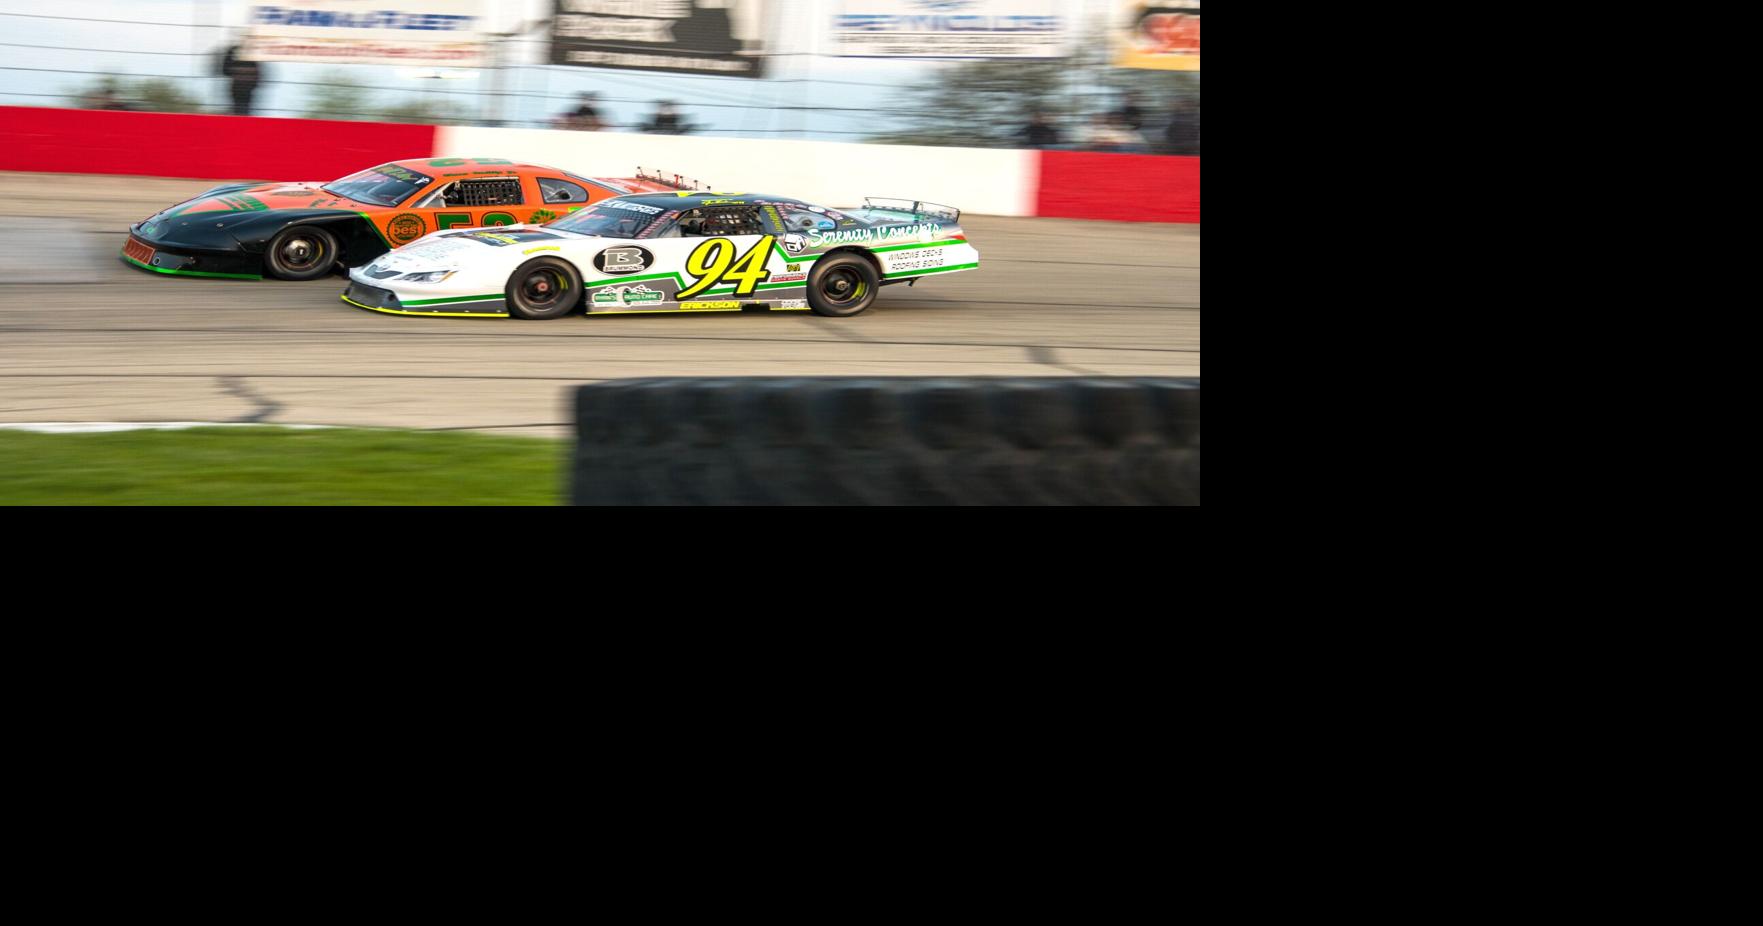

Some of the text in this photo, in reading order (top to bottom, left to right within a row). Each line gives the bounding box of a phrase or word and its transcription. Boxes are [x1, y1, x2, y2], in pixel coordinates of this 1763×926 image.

[807, 227, 873, 248] Serenity
[876, 223, 943, 241] Concepts
[674, 234, 777, 301] 94
[679, 300, 740, 311] ERICKSON
